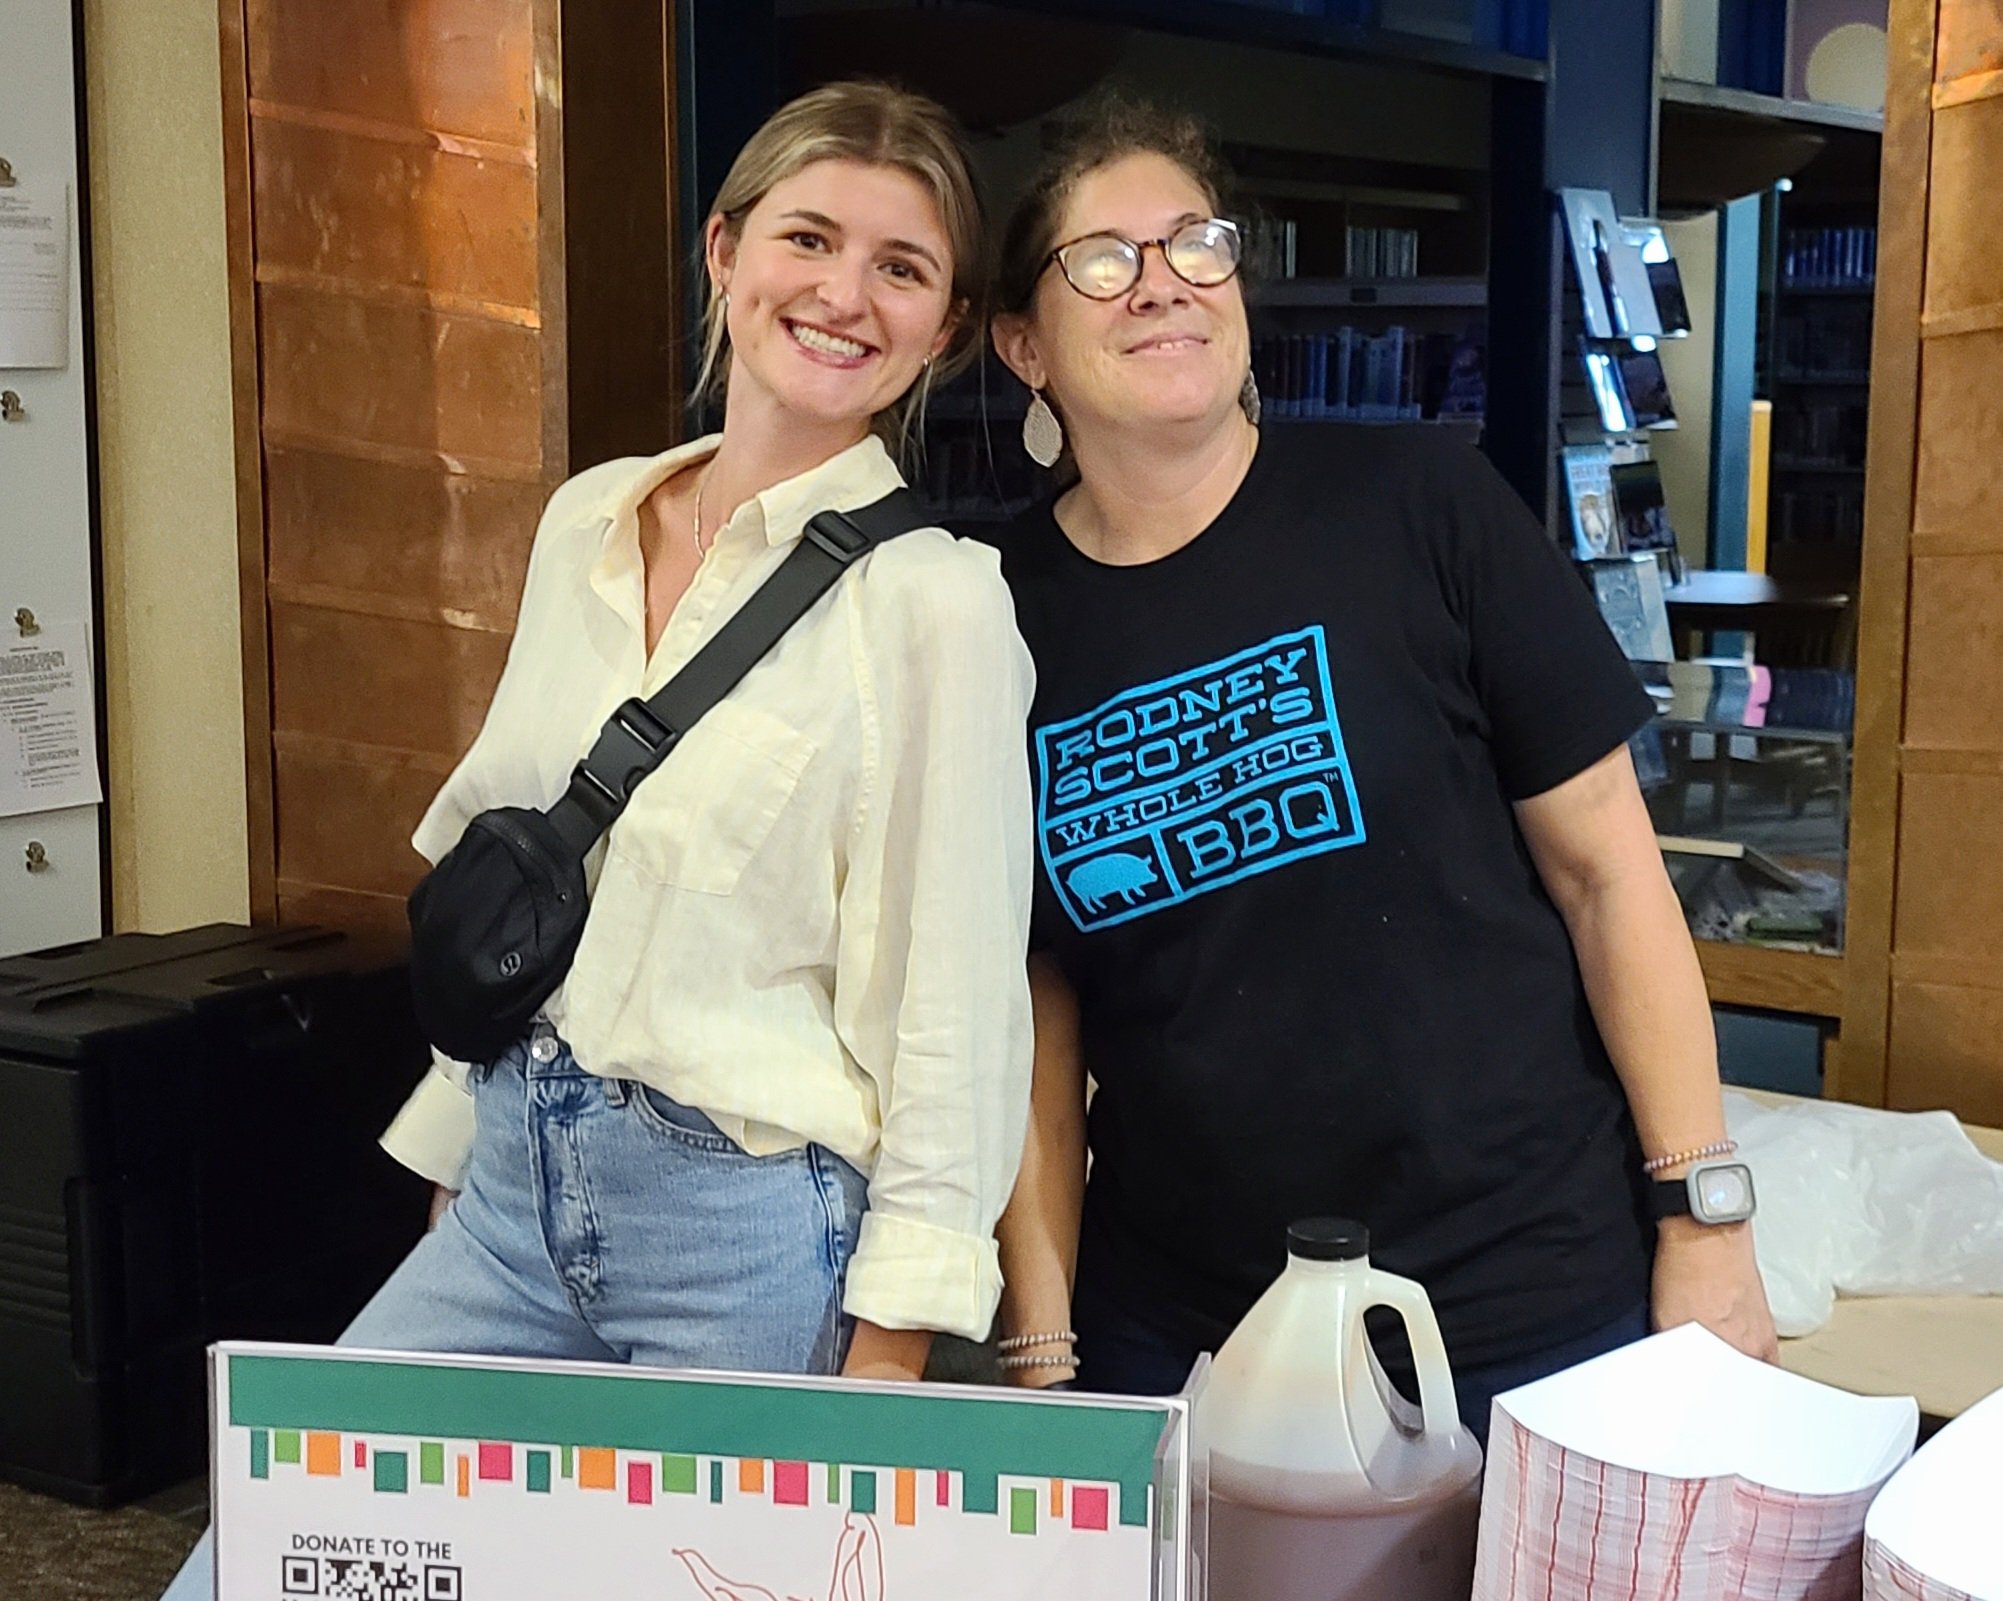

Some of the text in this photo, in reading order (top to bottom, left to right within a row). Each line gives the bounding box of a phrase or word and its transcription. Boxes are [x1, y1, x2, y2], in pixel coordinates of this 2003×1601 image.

[1054, 686, 1314, 806] SCOTT'S
[1055, 647, 1307, 771] RODNEY
[1055, 735, 1324, 847] WHOLE HOG
[1176, 780, 1341, 880] BBQ
[291, 1533, 452, 1560] DONATE TO THE
